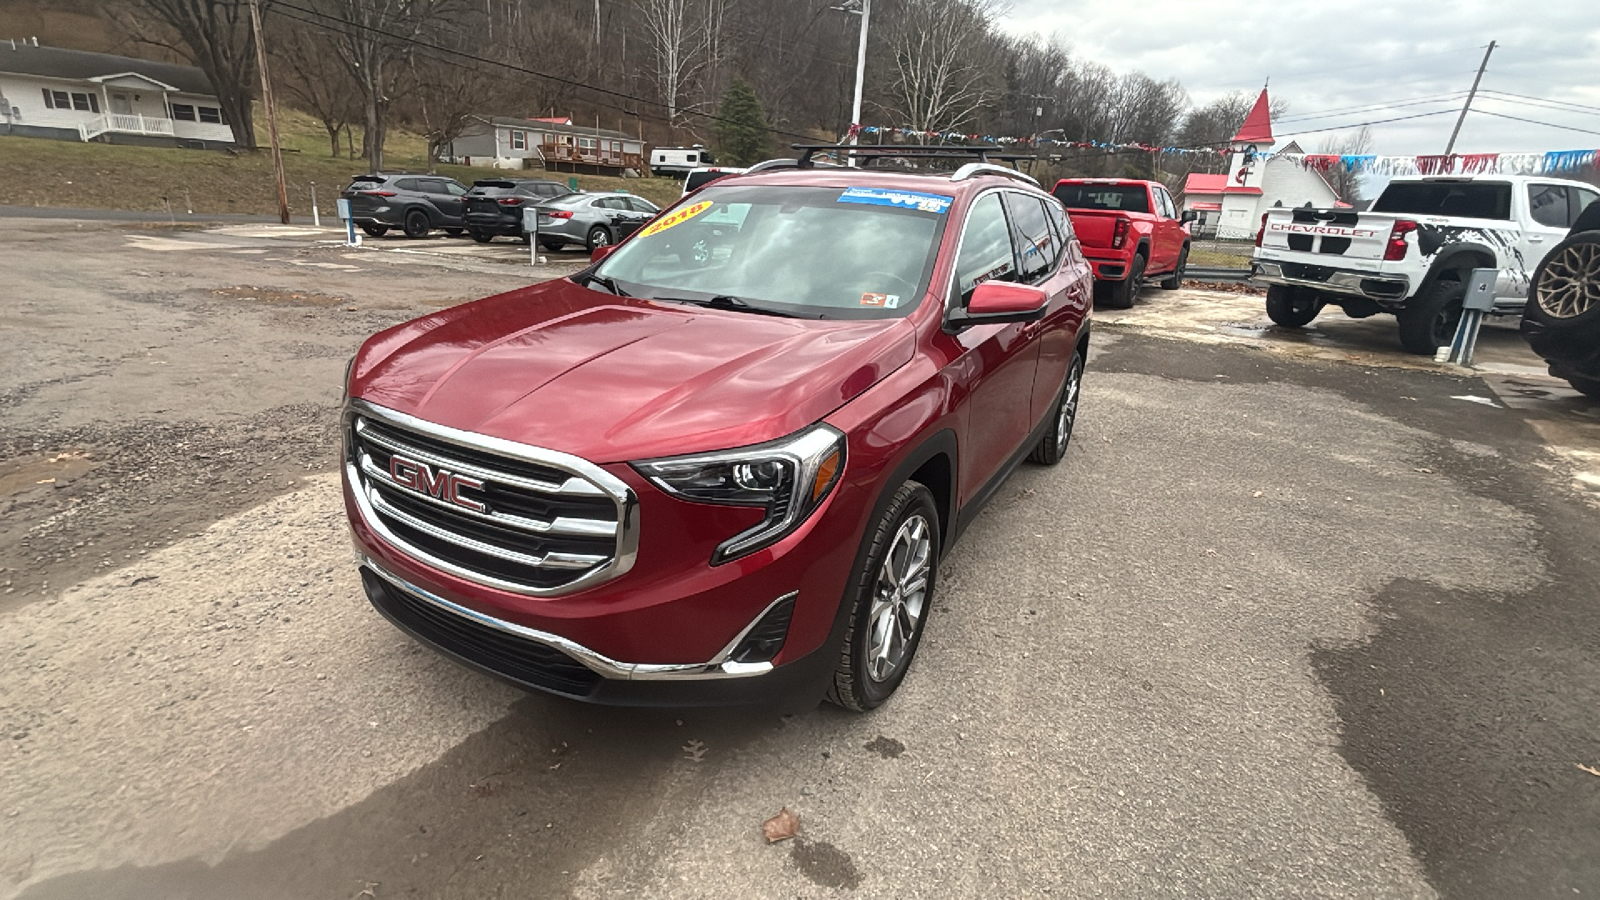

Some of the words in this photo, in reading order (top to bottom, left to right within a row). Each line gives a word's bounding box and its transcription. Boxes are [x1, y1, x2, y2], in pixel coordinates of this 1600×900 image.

[649, 204, 704, 234] 2018
[1271, 223, 1379, 238] CHEVROLET
[1479, 283, 1487, 291] 4
[390, 454, 486, 513] GMC
